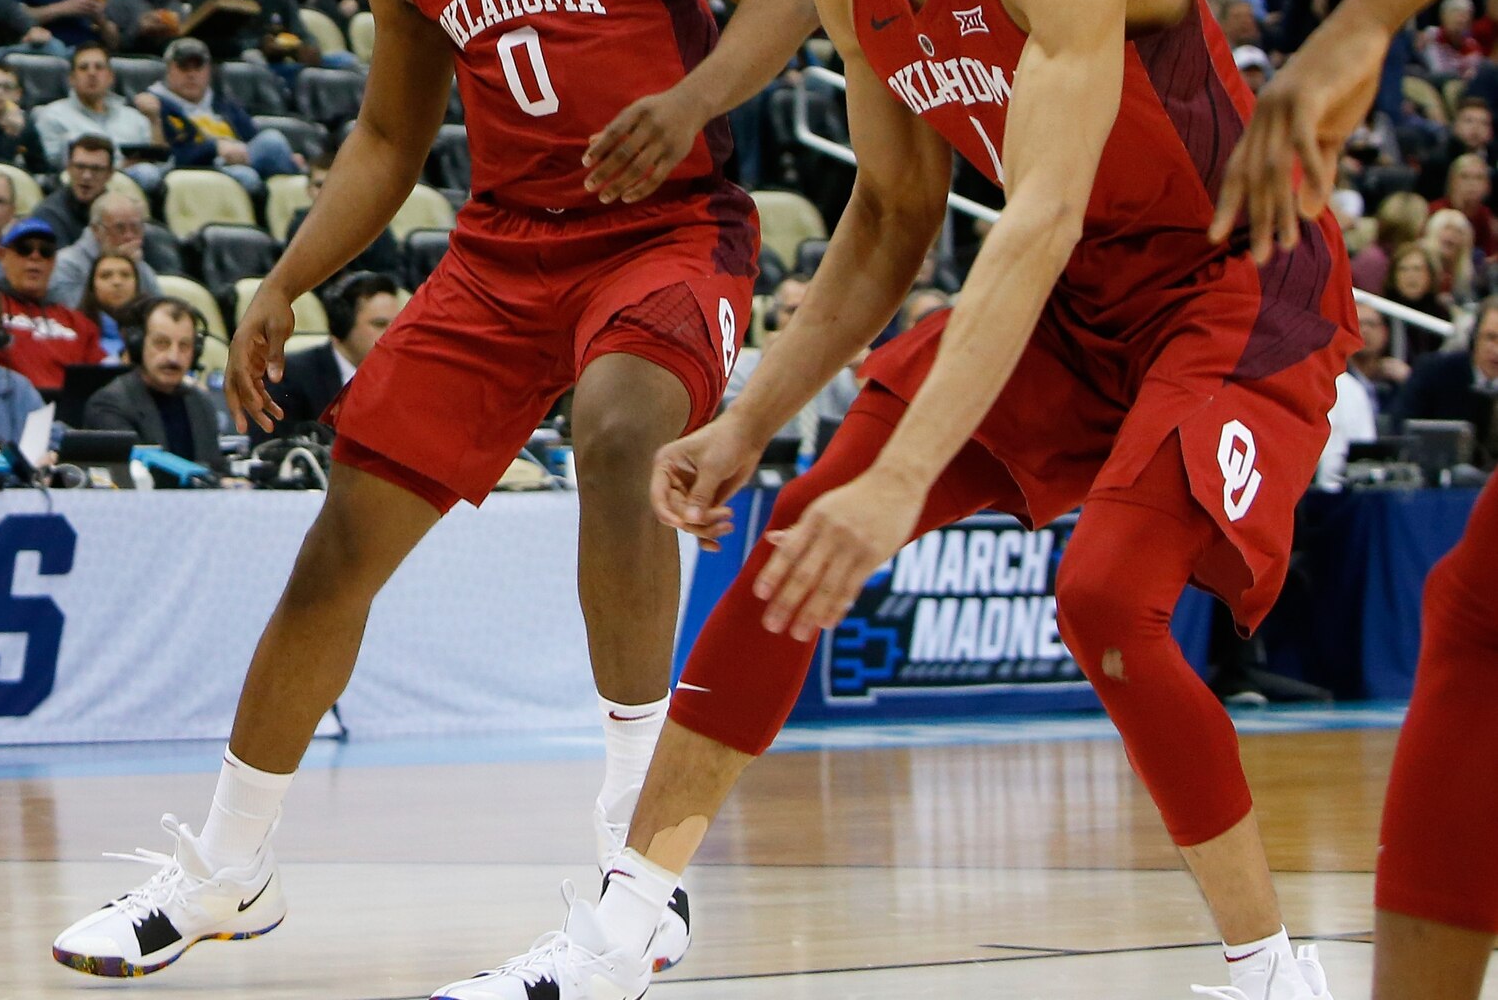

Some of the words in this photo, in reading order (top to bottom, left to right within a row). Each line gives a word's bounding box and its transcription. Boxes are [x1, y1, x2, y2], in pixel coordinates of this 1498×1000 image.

[497, 25, 560, 117] 0
[888, 56, 1015, 115] OKLAHOM
[1217, 419, 1263, 522] OU
[890, 529, 1054, 594] MARCH
[908, 596, 1073, 662] MADNE
